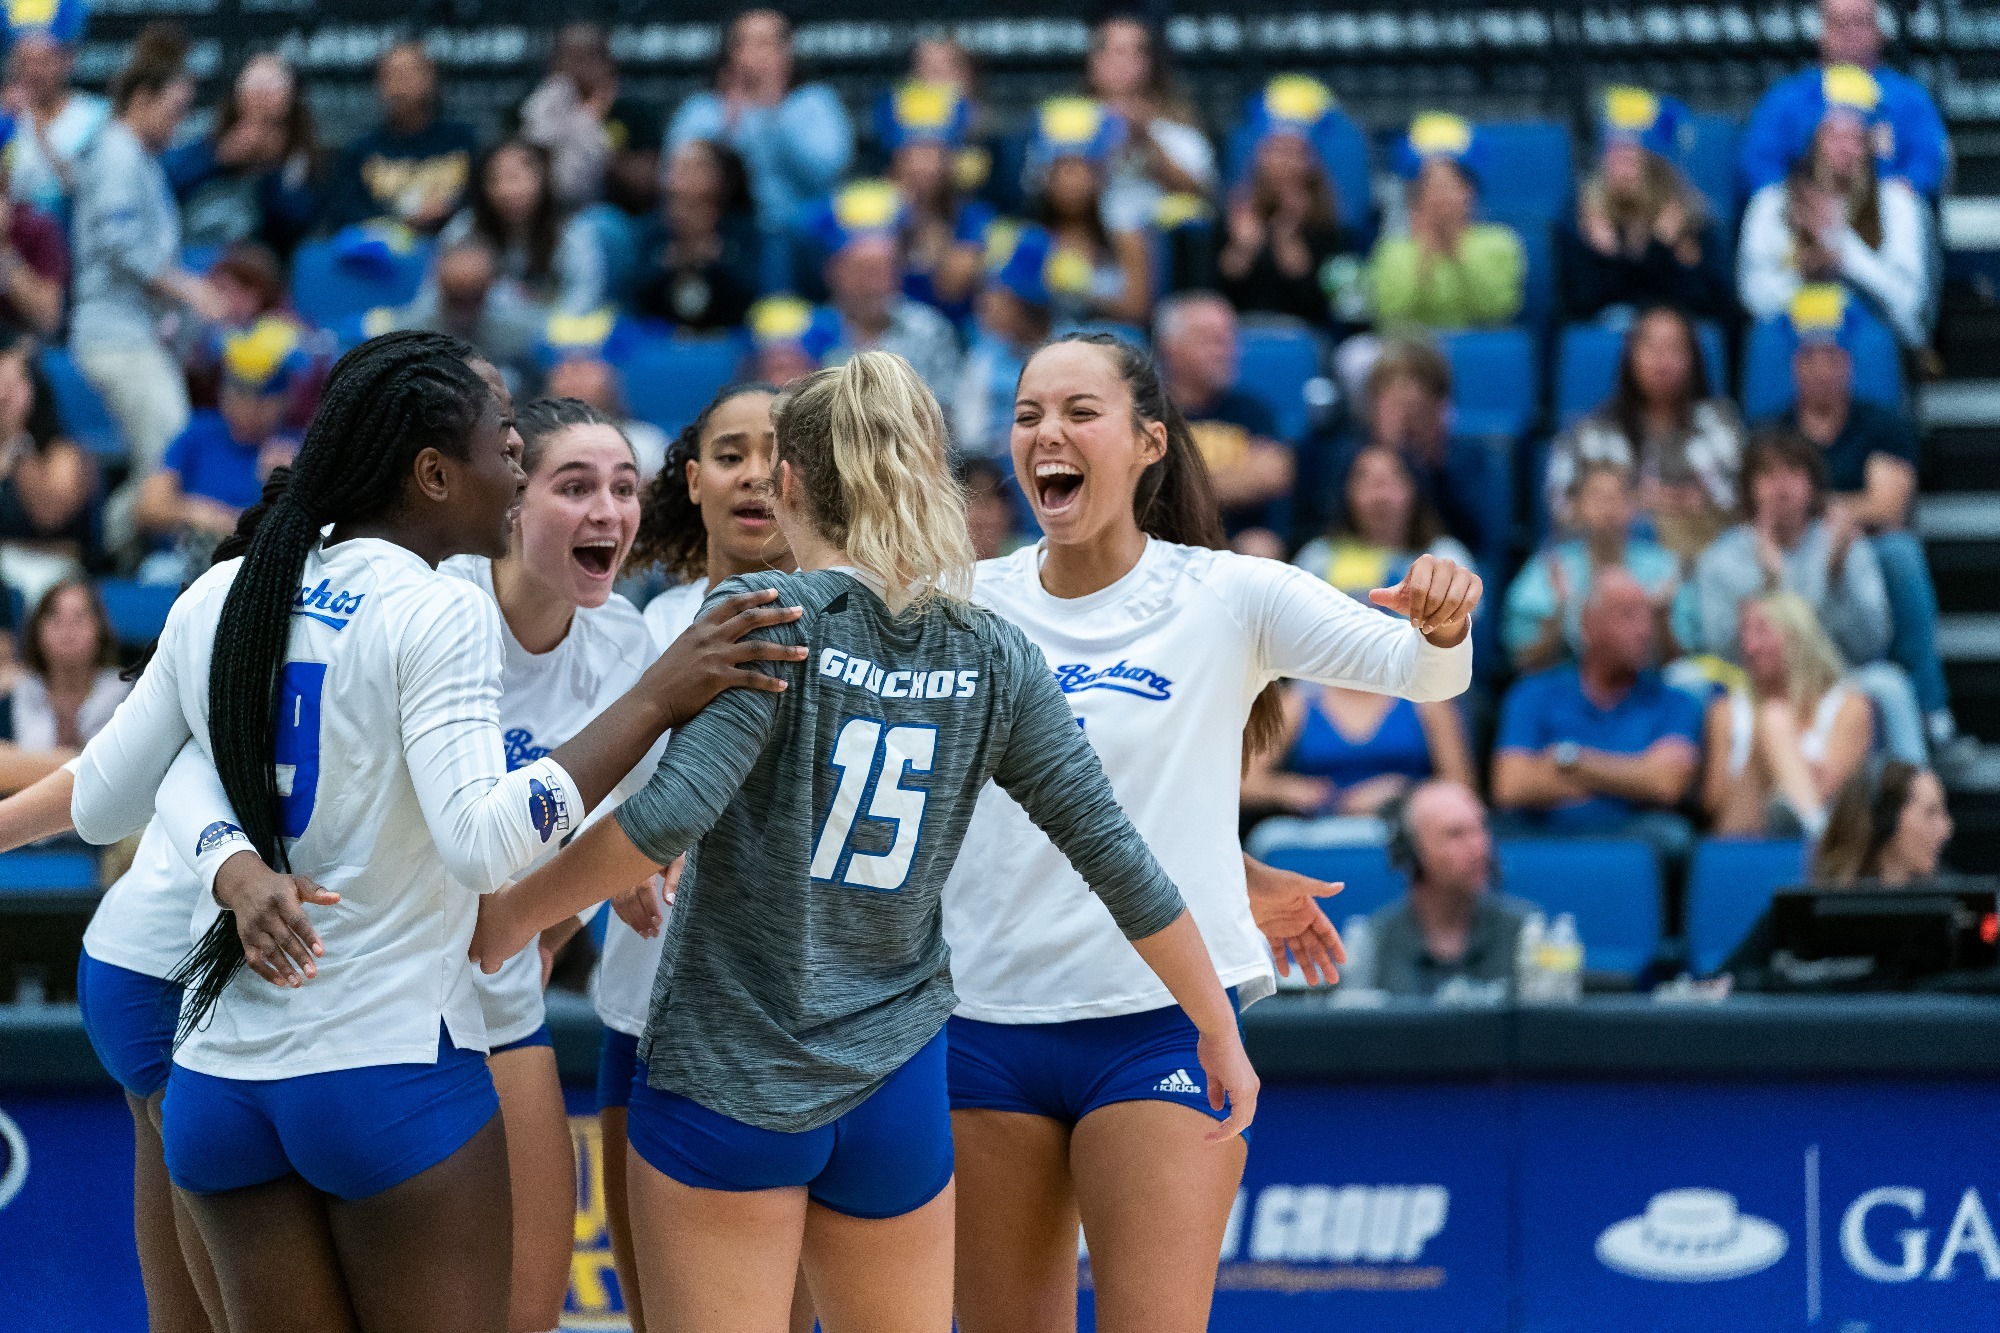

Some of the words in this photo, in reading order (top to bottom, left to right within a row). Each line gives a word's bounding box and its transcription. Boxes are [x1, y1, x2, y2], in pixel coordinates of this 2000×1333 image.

[819, 647, 979, 699] GAUCHOS
[274, 661, 328, 839] 9
[810, 715, 940, 894] 15
[1839, 1185, 2000, 1283] GA
